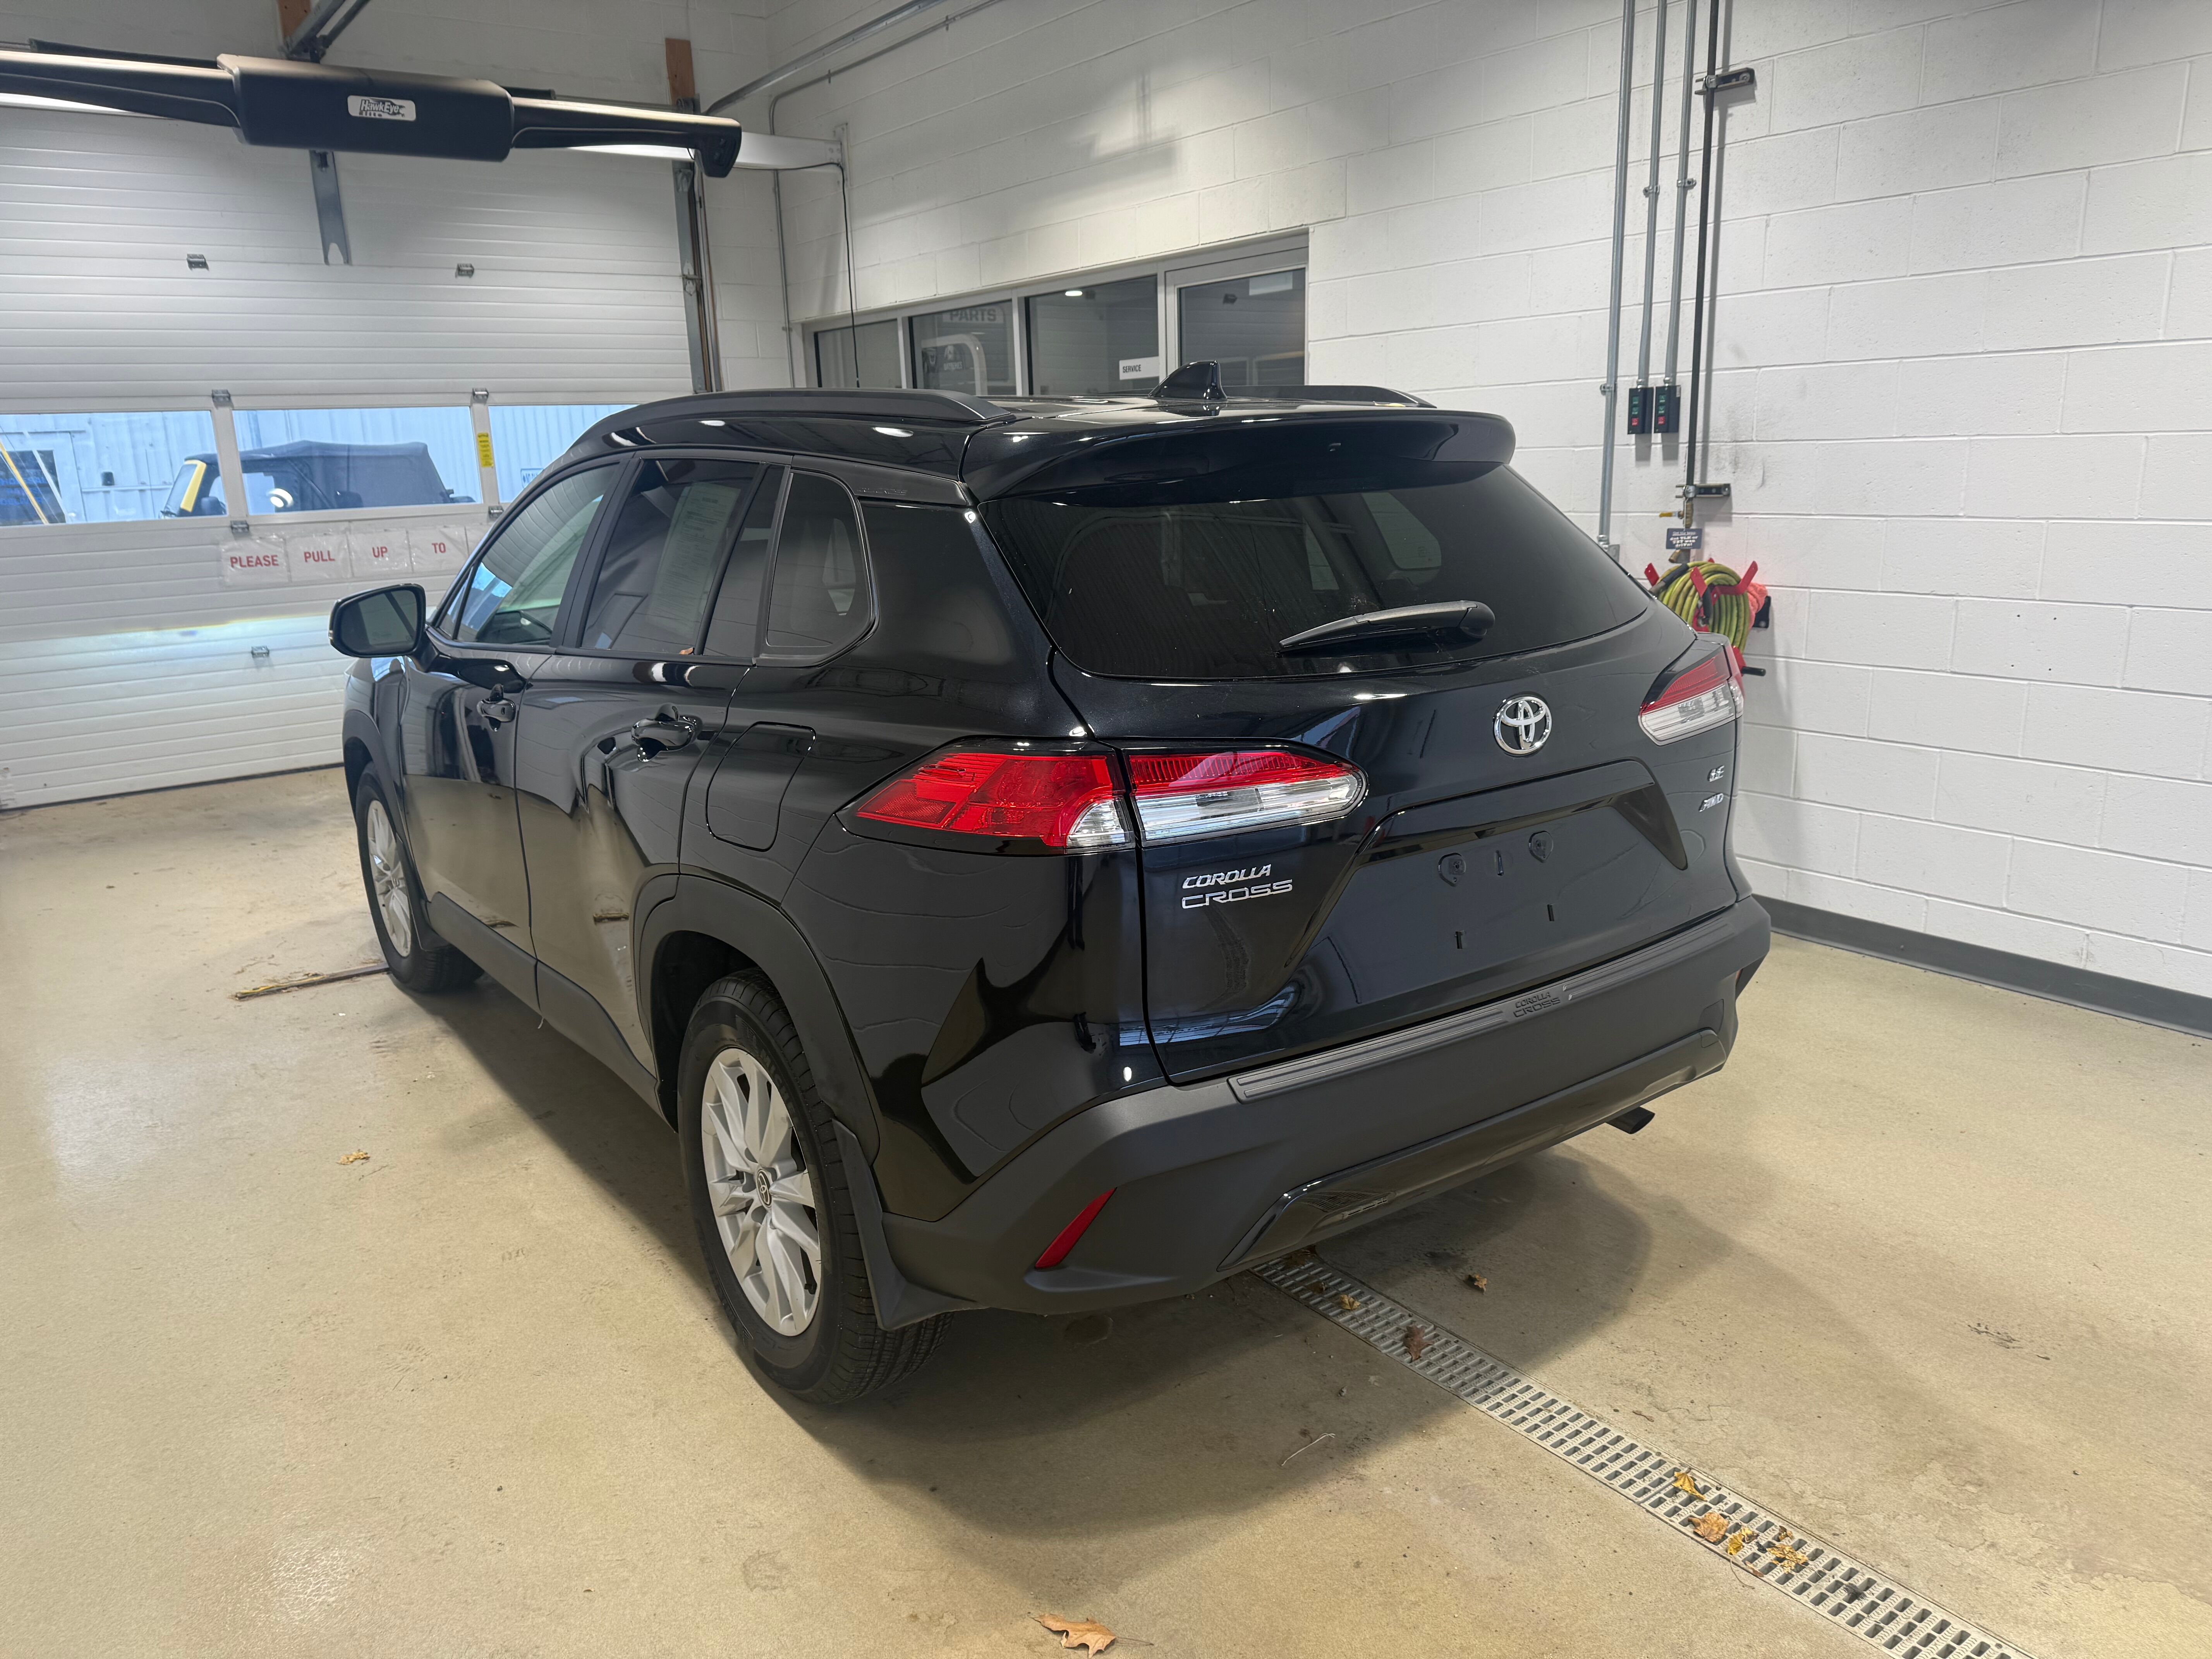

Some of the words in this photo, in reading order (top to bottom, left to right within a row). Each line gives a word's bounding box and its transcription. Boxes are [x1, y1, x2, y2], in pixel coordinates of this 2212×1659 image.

[359, 99, 400, 113] HawkEye
[950, 308, 997, 322] PARTS
[1123, 364, 1142, 373] SERVICE
[230, 555, 279, 568] PLEASE
[304, 550, 335, 562] PULL
[372, 546, 388, 558] UP
[431, 542, 446, 554] TO
[1182, 864, 1271, 889] COROLLA
[1182, 879, 1293, 909] CROSS
[1513, 997, 1561, 1017] CROSS
[1515, 992, 1551, 1008] COROLLA
